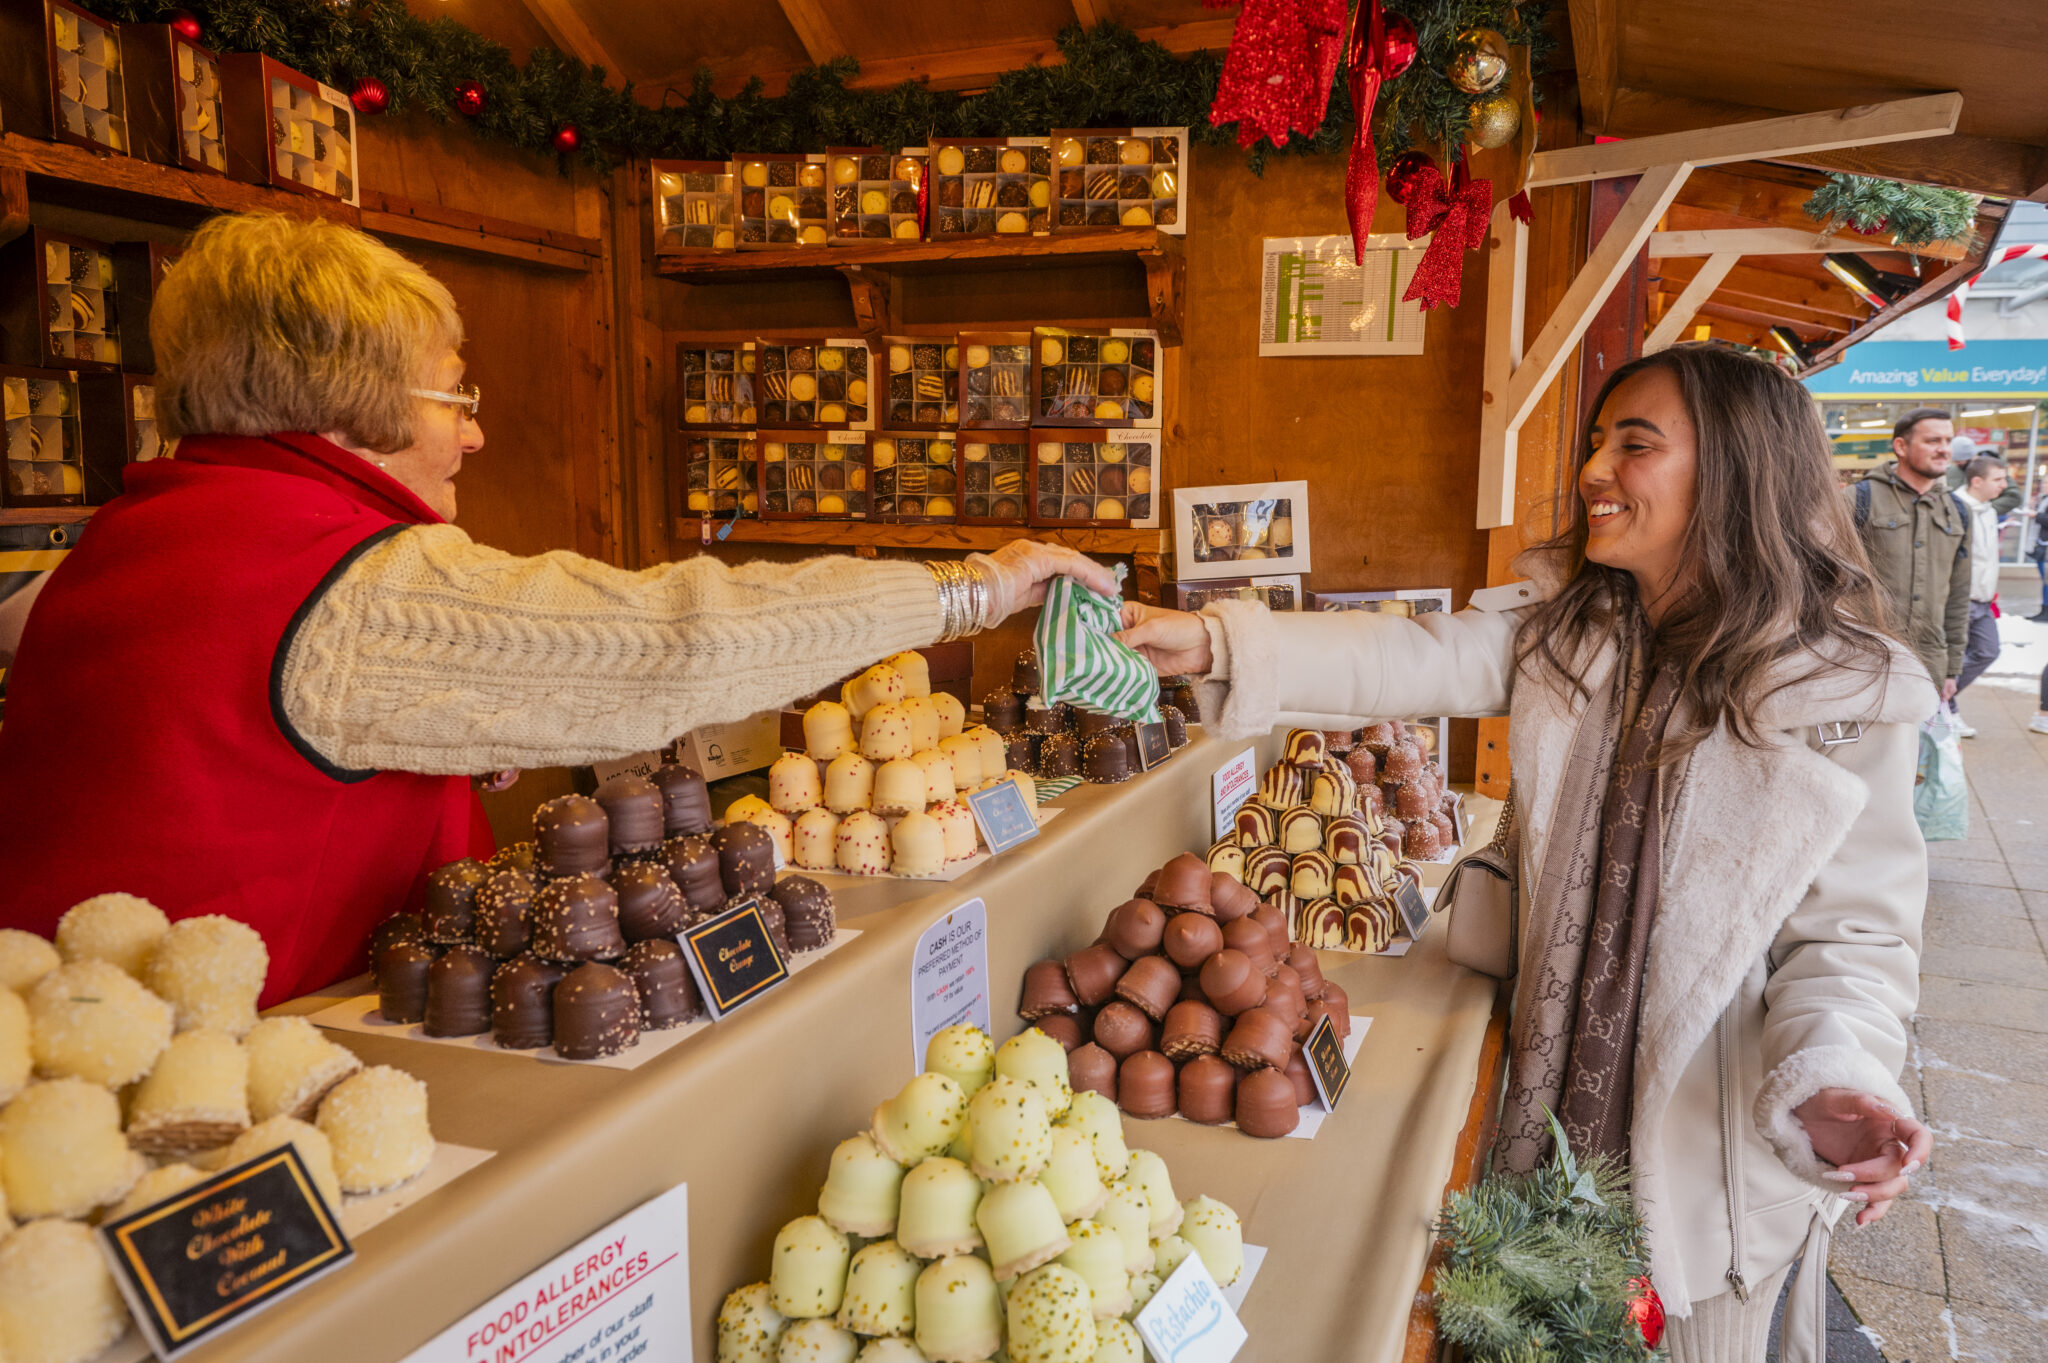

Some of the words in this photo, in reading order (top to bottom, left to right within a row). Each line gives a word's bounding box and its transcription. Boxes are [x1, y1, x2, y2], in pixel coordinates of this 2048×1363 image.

[1849, 369, 1918, 387] Amazing
[1921, 368, 1969, 383] Value
[1971, 366, 2047, 385] Everyday!
[1117, 431, 1154, 441] Chocolate
[719, 939, 752, 962] Chocolate
[918, 948, 951, 977] PREFERRED
[951, 934, 974, 955] METHOD
[974, 928, 982, 941] OF
[929, 934, 948, 956] CASH
[948, 929, 956, 942] IS
[956, 920, 972, 938] OUR
[938, 953, 963, 977] PAYMENT
[936, 984, 949, 997] CASH
[191, 1198, 248, 1228] White
[186, 1209, 273, 1260] Chocolate
[467, 1301, 528, 1358] FOOD
[534, 1235, 627, 1313] ALLERGY
[495, 1251, 649, 1363] INTOLERANCES
[589, 1328, 603, 1349] of
[604, 1315, 626, 1339] our
[628, 1293, 654, 1322] staff
[1148, 1280, 1211, 1354] Pistachio
[614, 1324, 642, 1354] your
